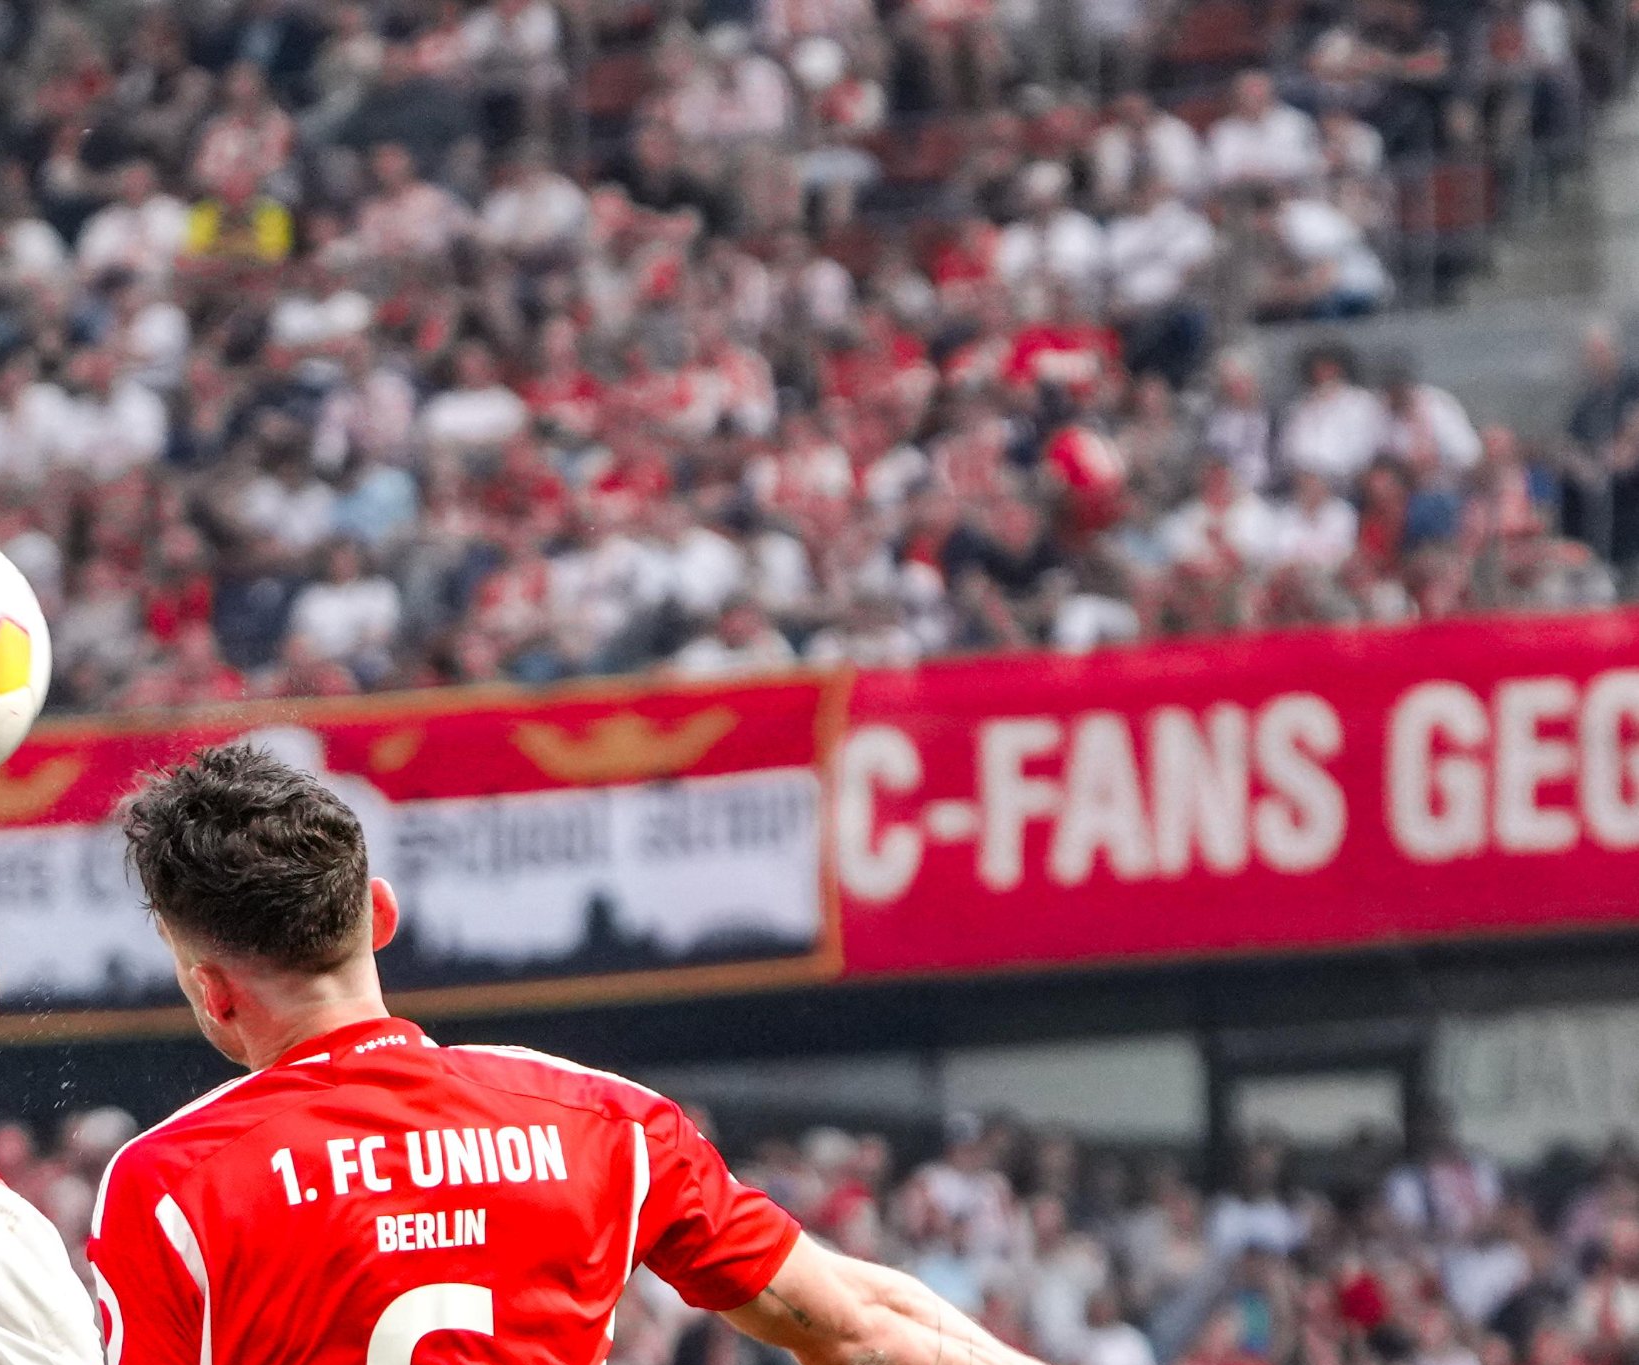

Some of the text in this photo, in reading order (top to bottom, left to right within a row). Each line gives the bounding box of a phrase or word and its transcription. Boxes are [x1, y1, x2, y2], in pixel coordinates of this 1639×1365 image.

[837, 693, 1348, 903] C-FANS
[271, 1124, 568, 1205] 1. FC UNION
[376, 1208, 487, 1253] BERLIN
